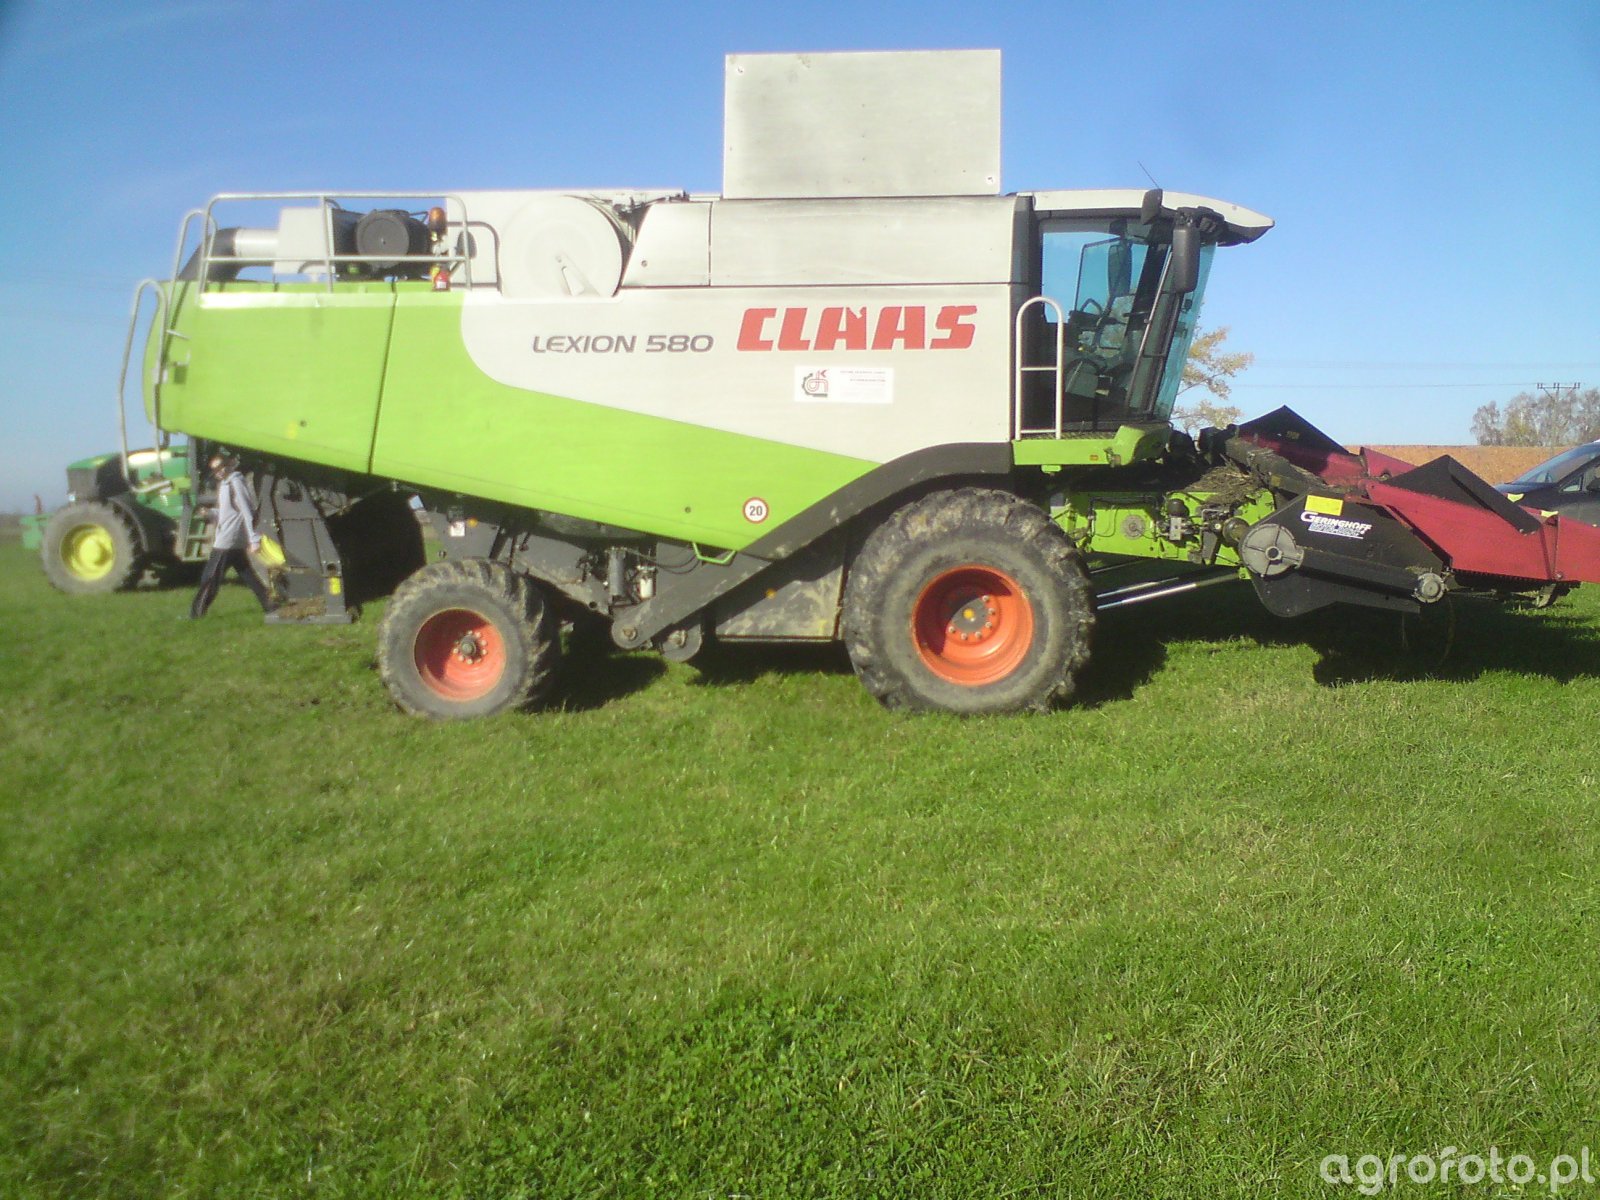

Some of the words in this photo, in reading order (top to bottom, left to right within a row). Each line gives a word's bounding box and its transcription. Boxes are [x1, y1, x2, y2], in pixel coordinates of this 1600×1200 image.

[736, 305, 978, 351] CLAAS
[532, 335, 638, 354] LEXION
[645, 335, 714, 353] 580
[749, 505, 763, 516] 20
